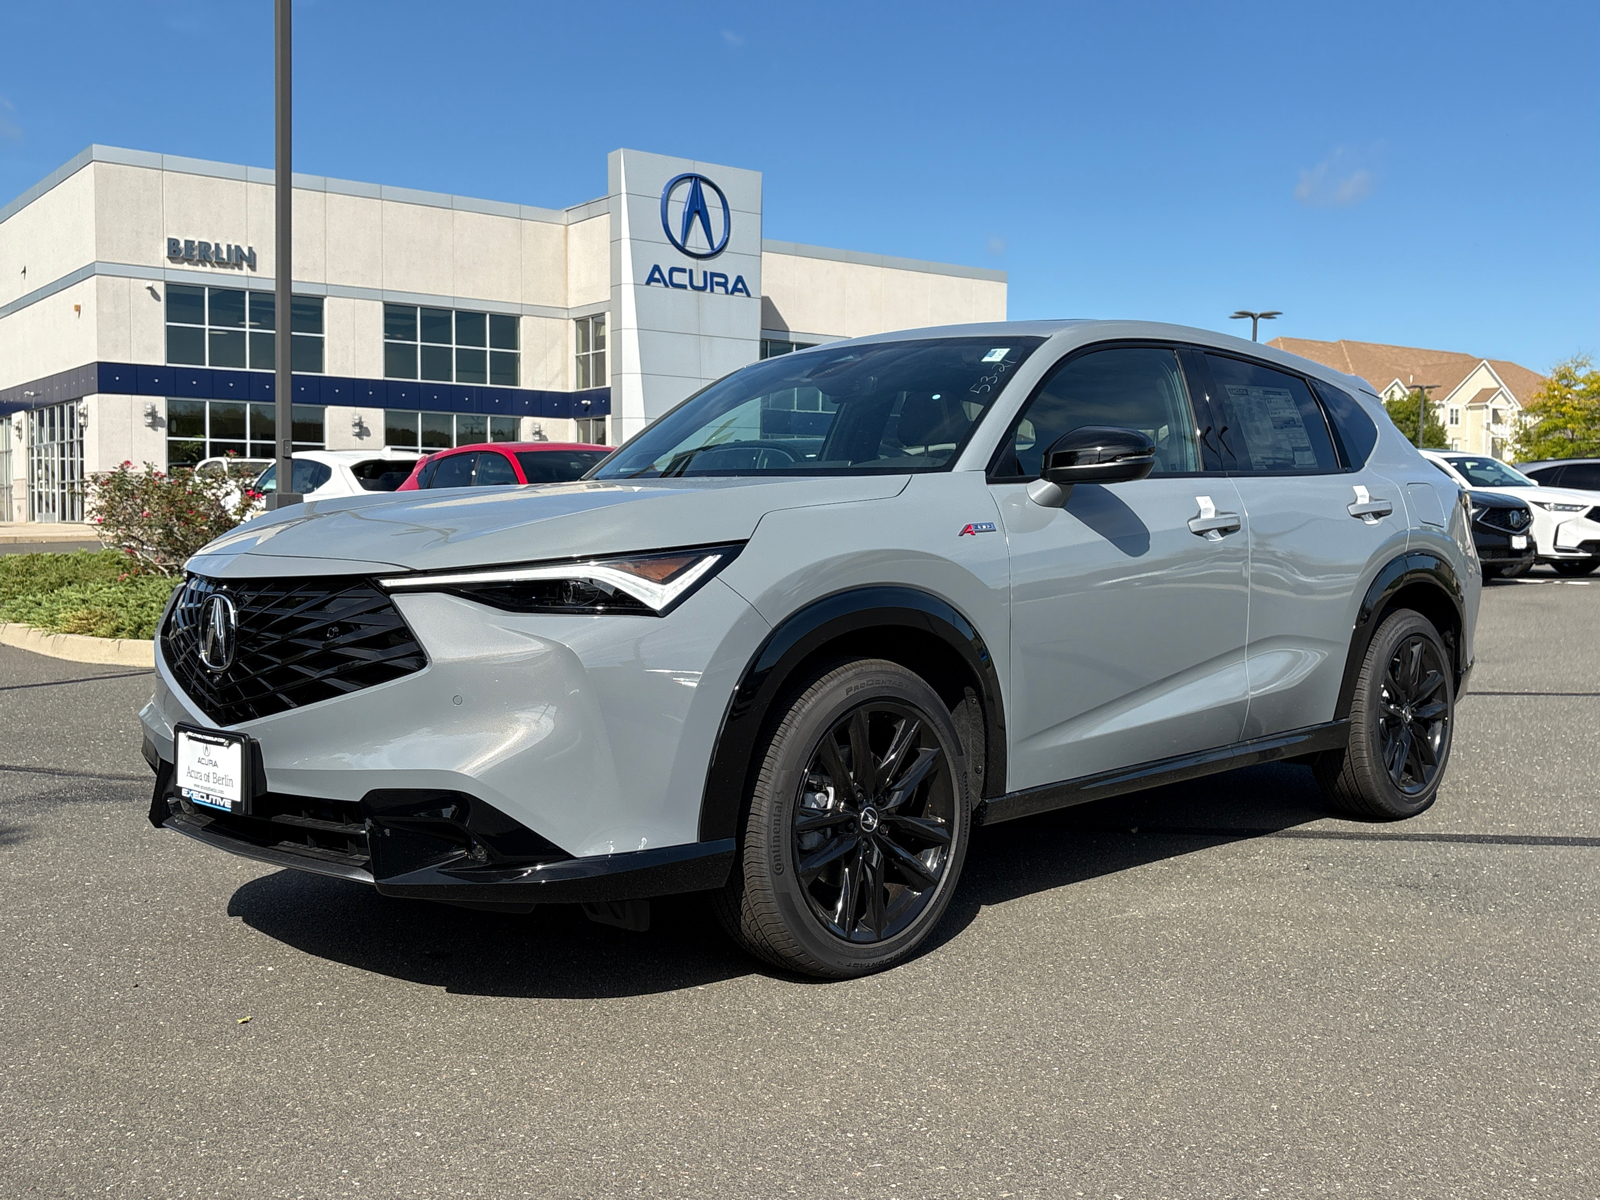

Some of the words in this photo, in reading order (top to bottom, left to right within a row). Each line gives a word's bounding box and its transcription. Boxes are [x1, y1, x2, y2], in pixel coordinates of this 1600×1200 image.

[167, 237, 255, 268] BERLIN
[645, 264, 751, 297] ACURA
[197, 757, 219, 768] ACURA
[186, 766, 203, 781] Acura
[203, 772, 211, 783] of
[212, 772, 234, 788] Berlin
[182, 787, 232, 807] EXECUTIVE
[770, 801, 785, 876] Continental
